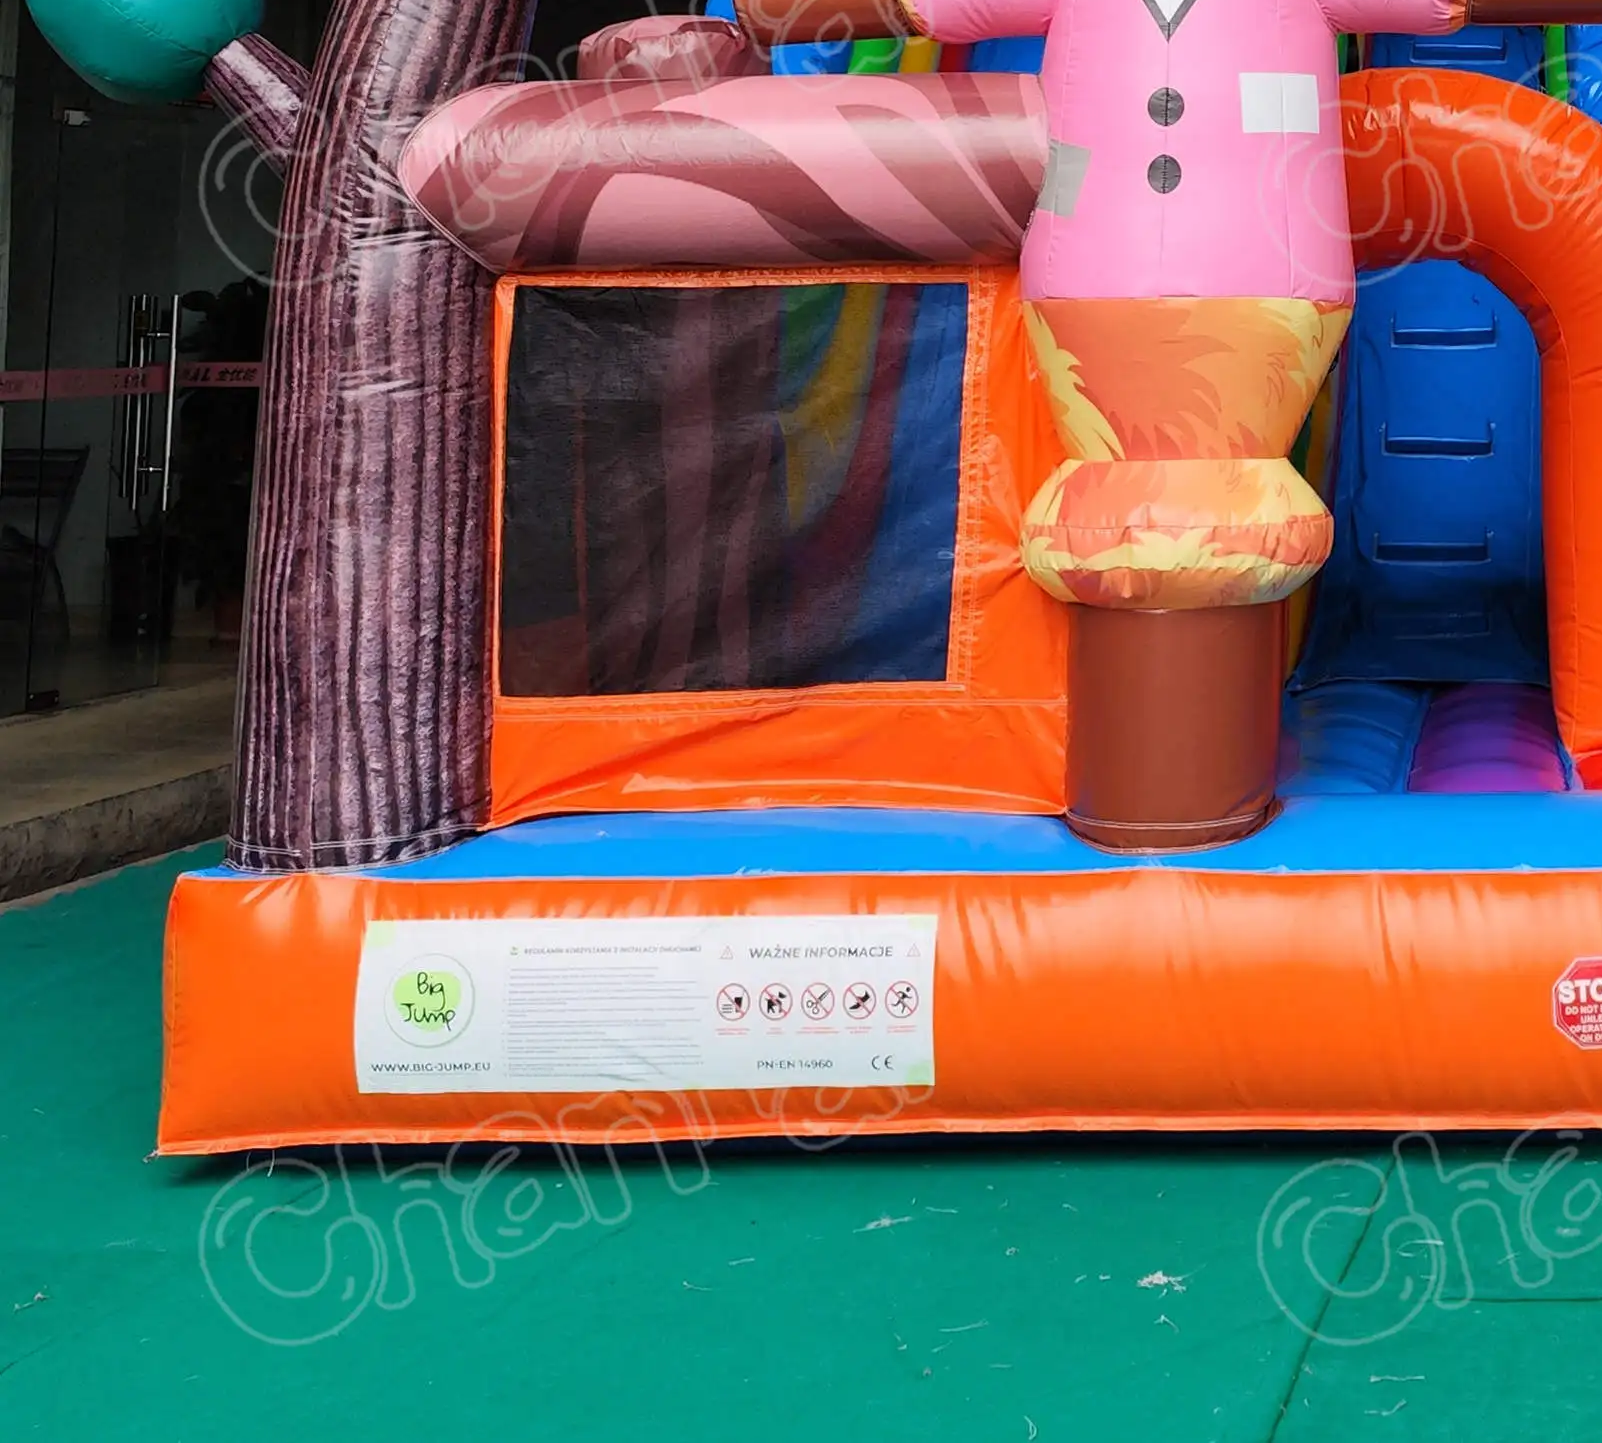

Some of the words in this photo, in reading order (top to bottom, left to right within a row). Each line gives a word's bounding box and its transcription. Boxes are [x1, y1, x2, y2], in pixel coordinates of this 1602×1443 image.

[749, 943, 801, 959] WAŻNE
[804, 945, 893, 959] INFORMACJE
[416, 971, 446, 1012] Big
[1564, 1006, 1578, 1015] DO
[1580, 1004, 1598, 1014] NOT
[400, 1002, 456, 1032] Jump
[1580, 1034, 1592, 1042] ON
[370, 1062, 491, 1073] WWW.BIG-JUMP.EU
